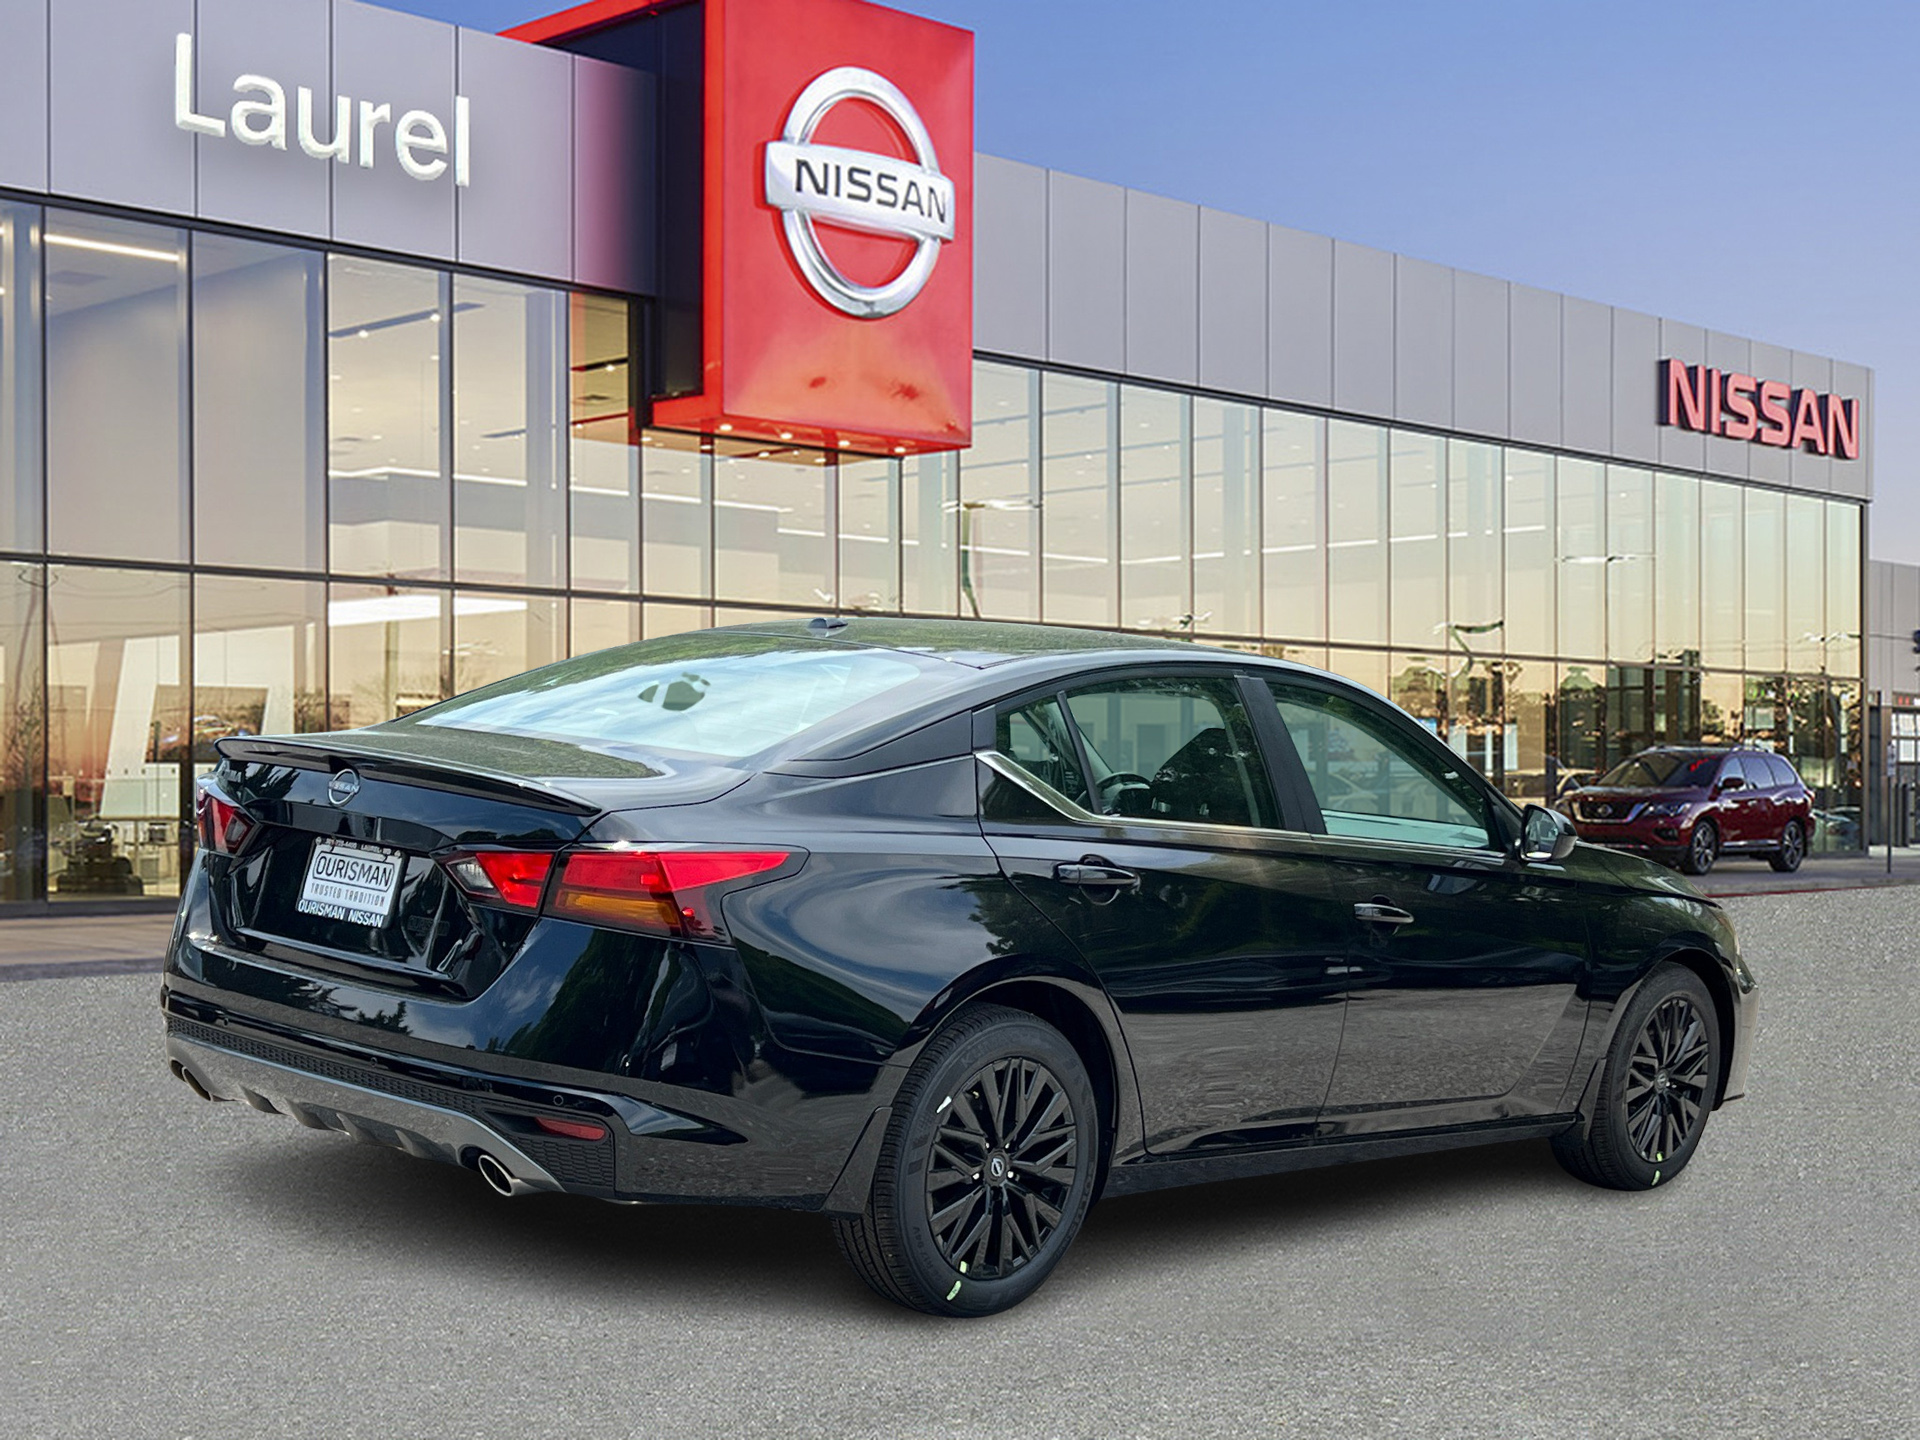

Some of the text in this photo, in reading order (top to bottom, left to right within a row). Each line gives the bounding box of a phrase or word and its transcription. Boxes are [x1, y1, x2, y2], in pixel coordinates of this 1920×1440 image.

[175, 33, 470, 188] Laurel
[795, 158, 946, 223] NISSAN
[1658, 358, 1860, 459] NISSAN
[310, 882, 386, 908] TRUSTED TRADITION
[315, 855, 392, 887] OURISMAN
[298, 899, 384, 928] OURISMAN NISSAN
